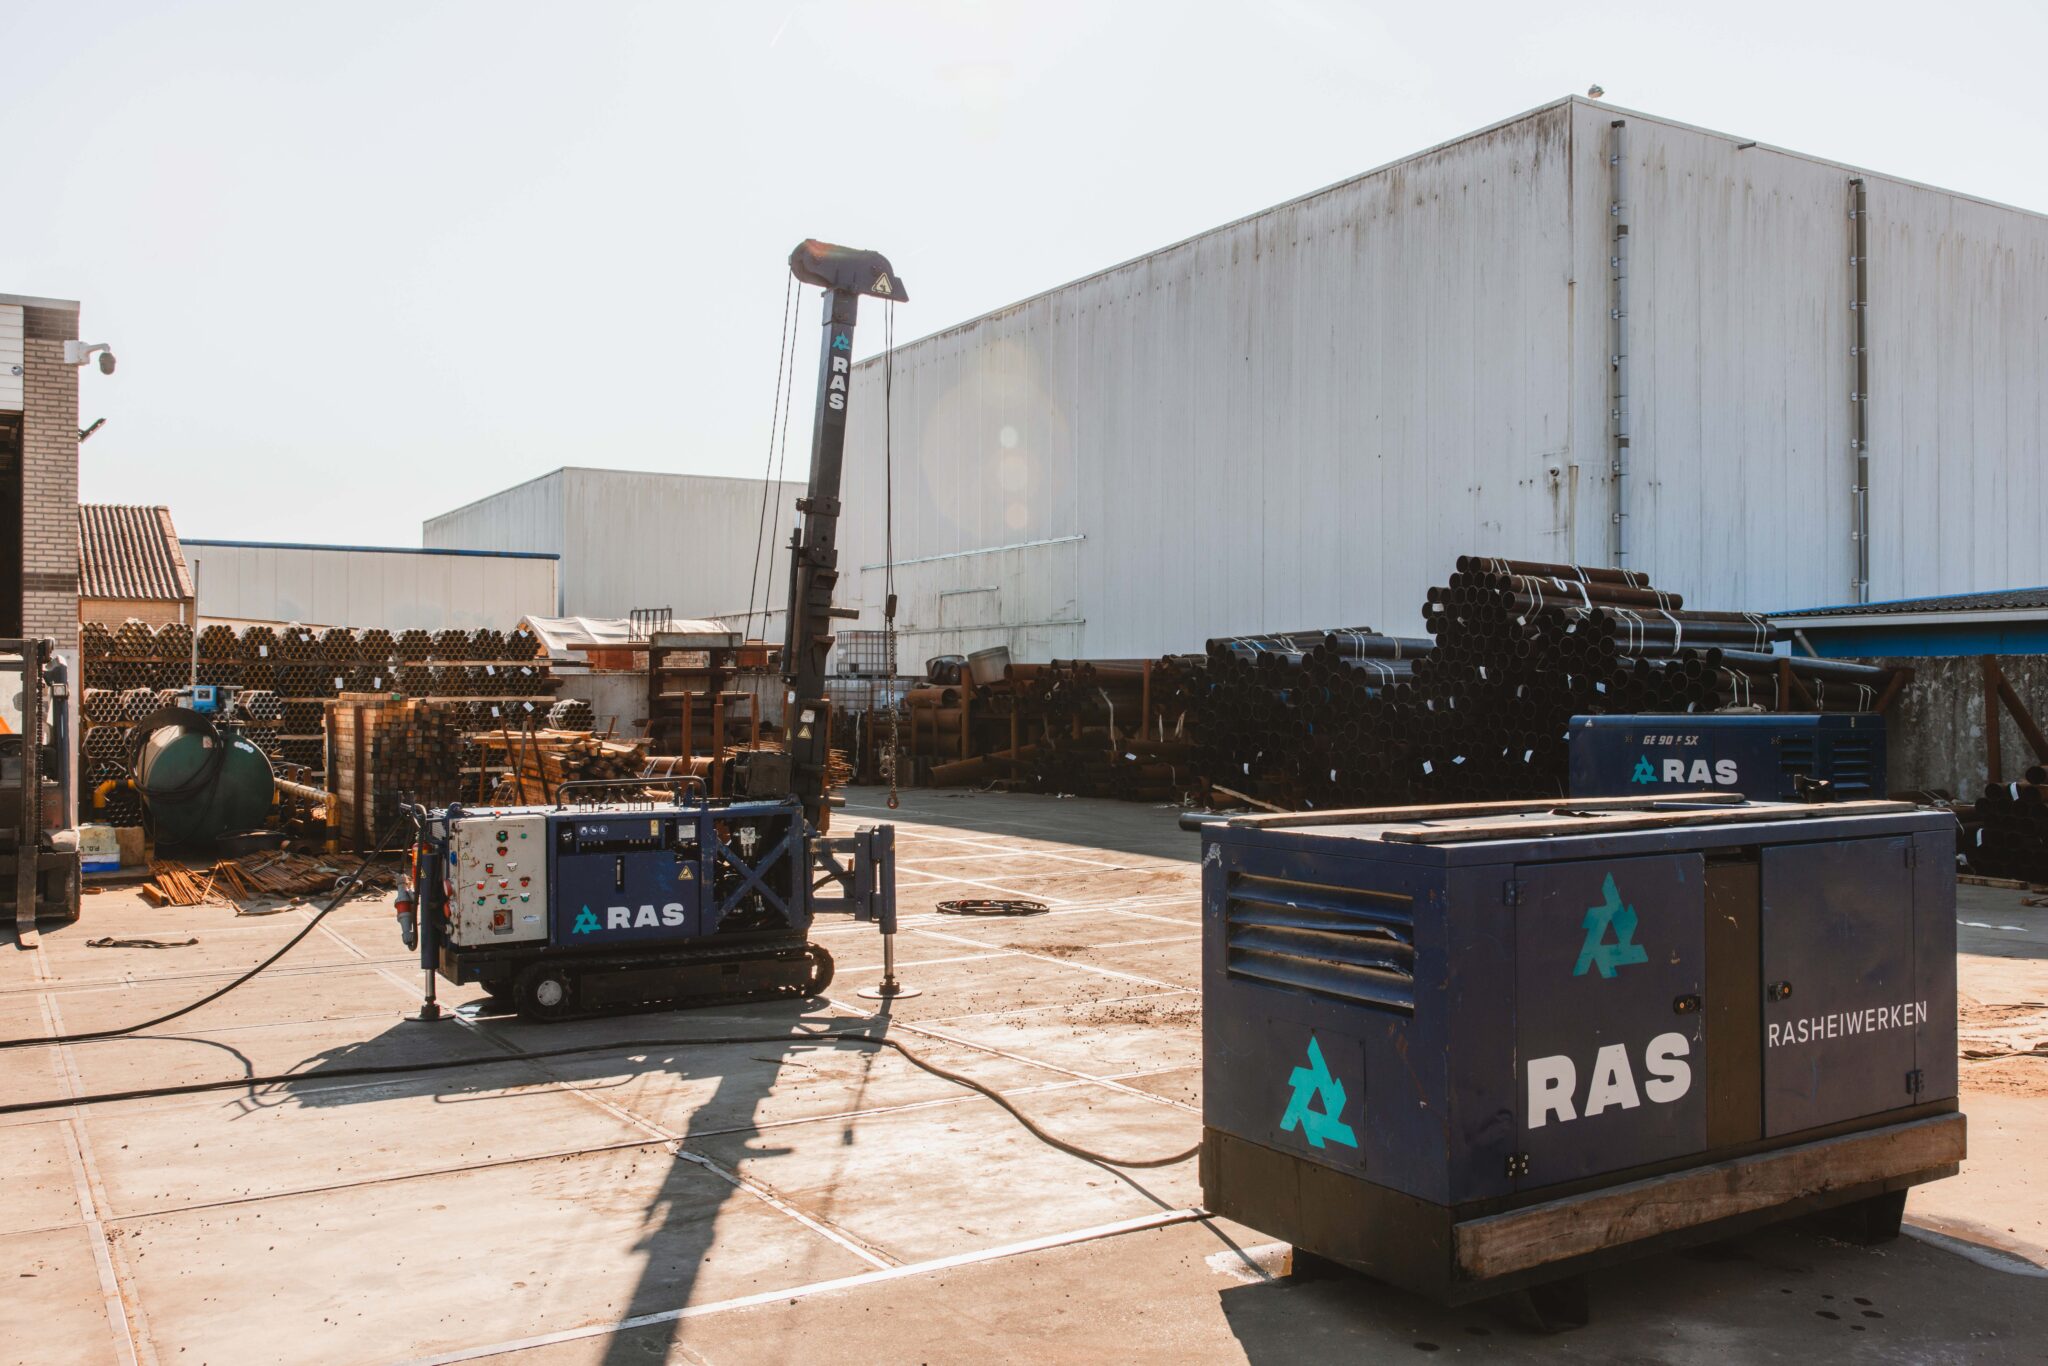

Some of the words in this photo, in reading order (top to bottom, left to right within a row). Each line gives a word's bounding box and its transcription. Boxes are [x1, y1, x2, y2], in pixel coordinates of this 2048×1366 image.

[828, 356, 849, 411] RAS
[1643, 735, 1656, 745] GE
[1658, 735, 1674, 745] 90
[1663, 758, 1738, 785] RAS
[607, 903, 685, 930] RAS
[1768, 1000, 1928, 1048] RASHEIWERKEN
[1526, 1032, 1693, 1130] RAS
